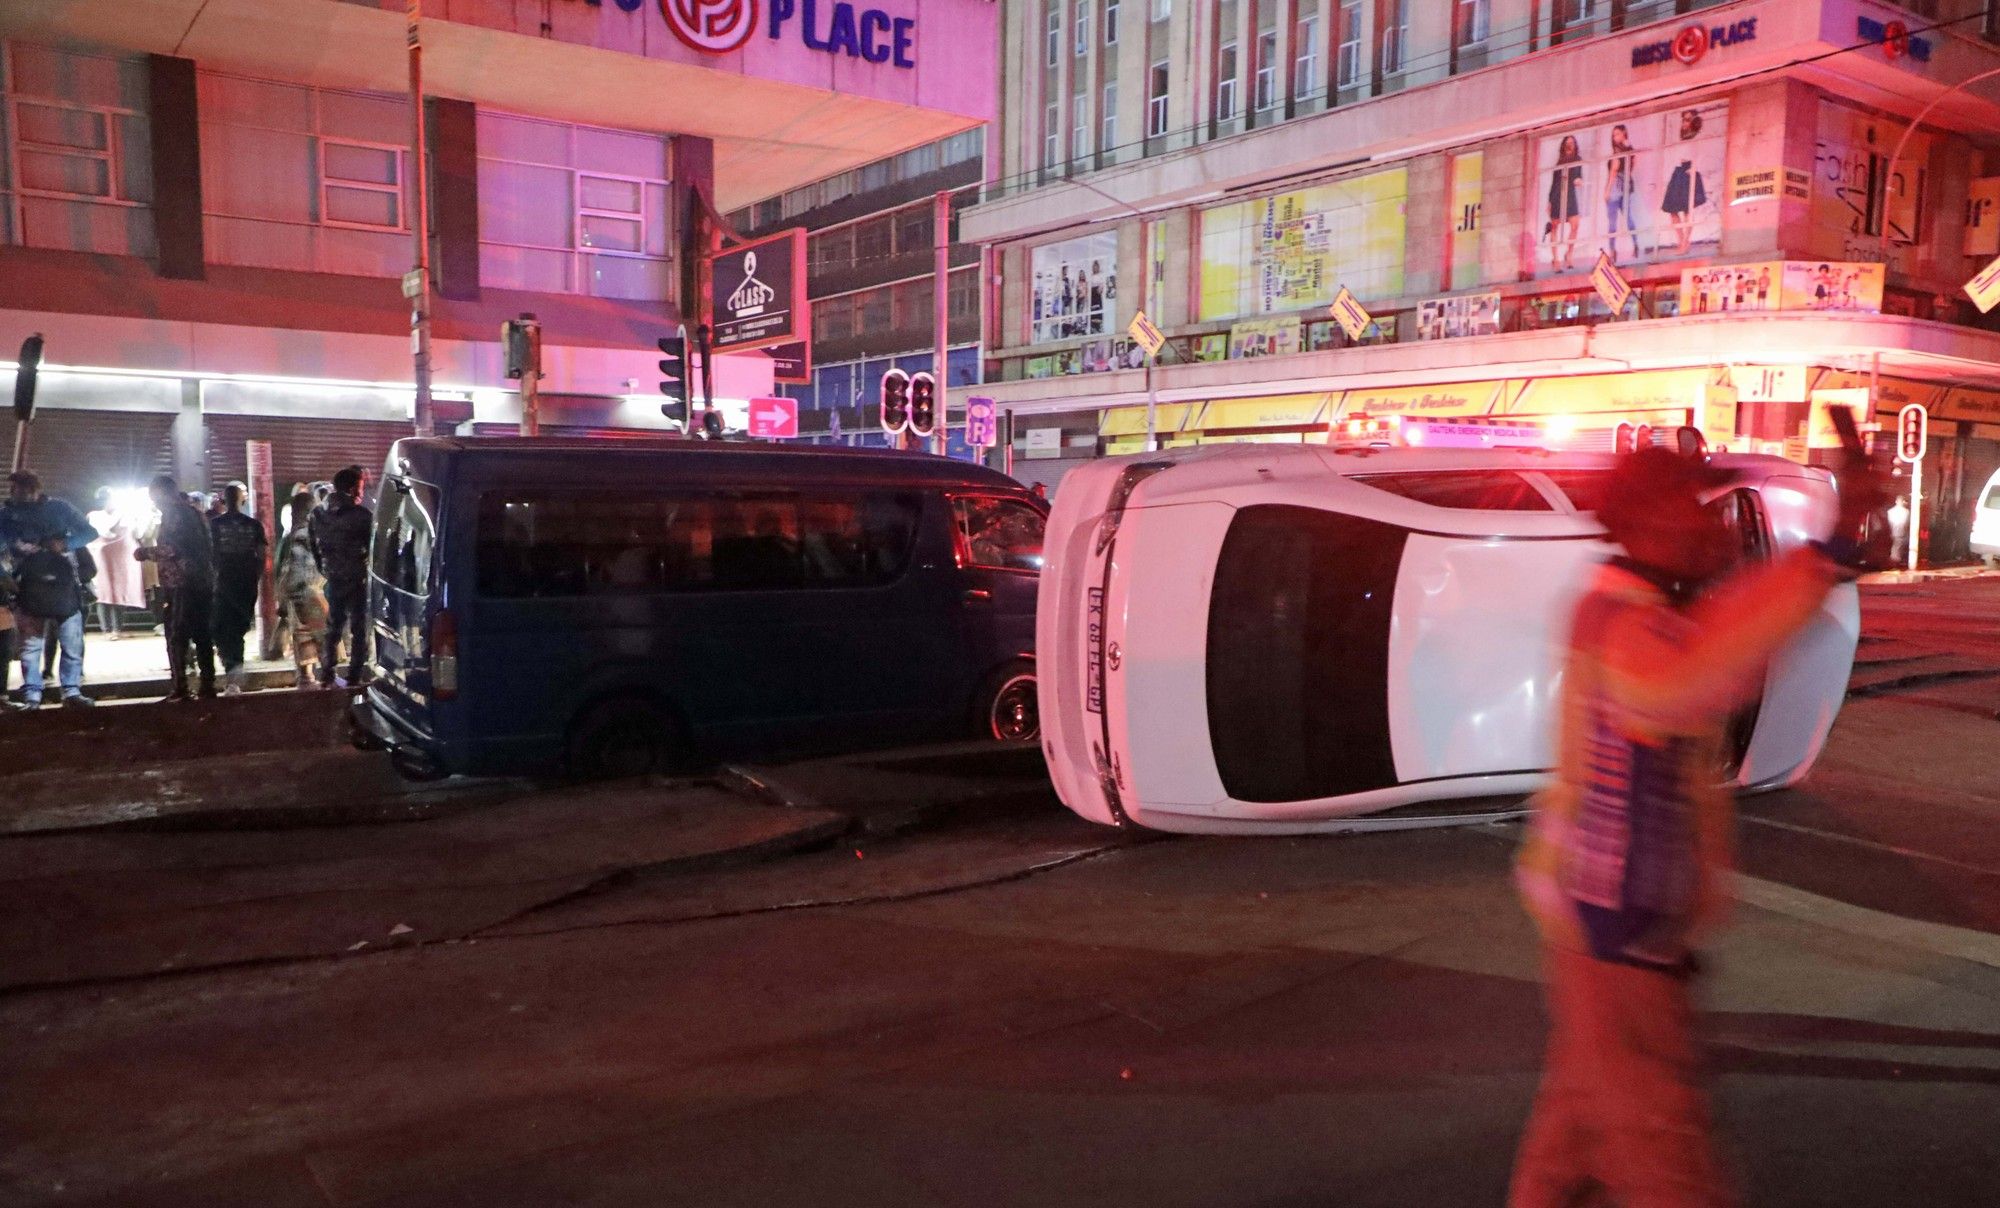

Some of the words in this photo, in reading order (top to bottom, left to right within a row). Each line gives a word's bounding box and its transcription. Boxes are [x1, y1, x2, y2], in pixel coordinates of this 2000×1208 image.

[768, 0, 915, 69] PLACE
[1736, 171, 1775, 186] WELCOME
[735, 285, 766, 309] CLASS
